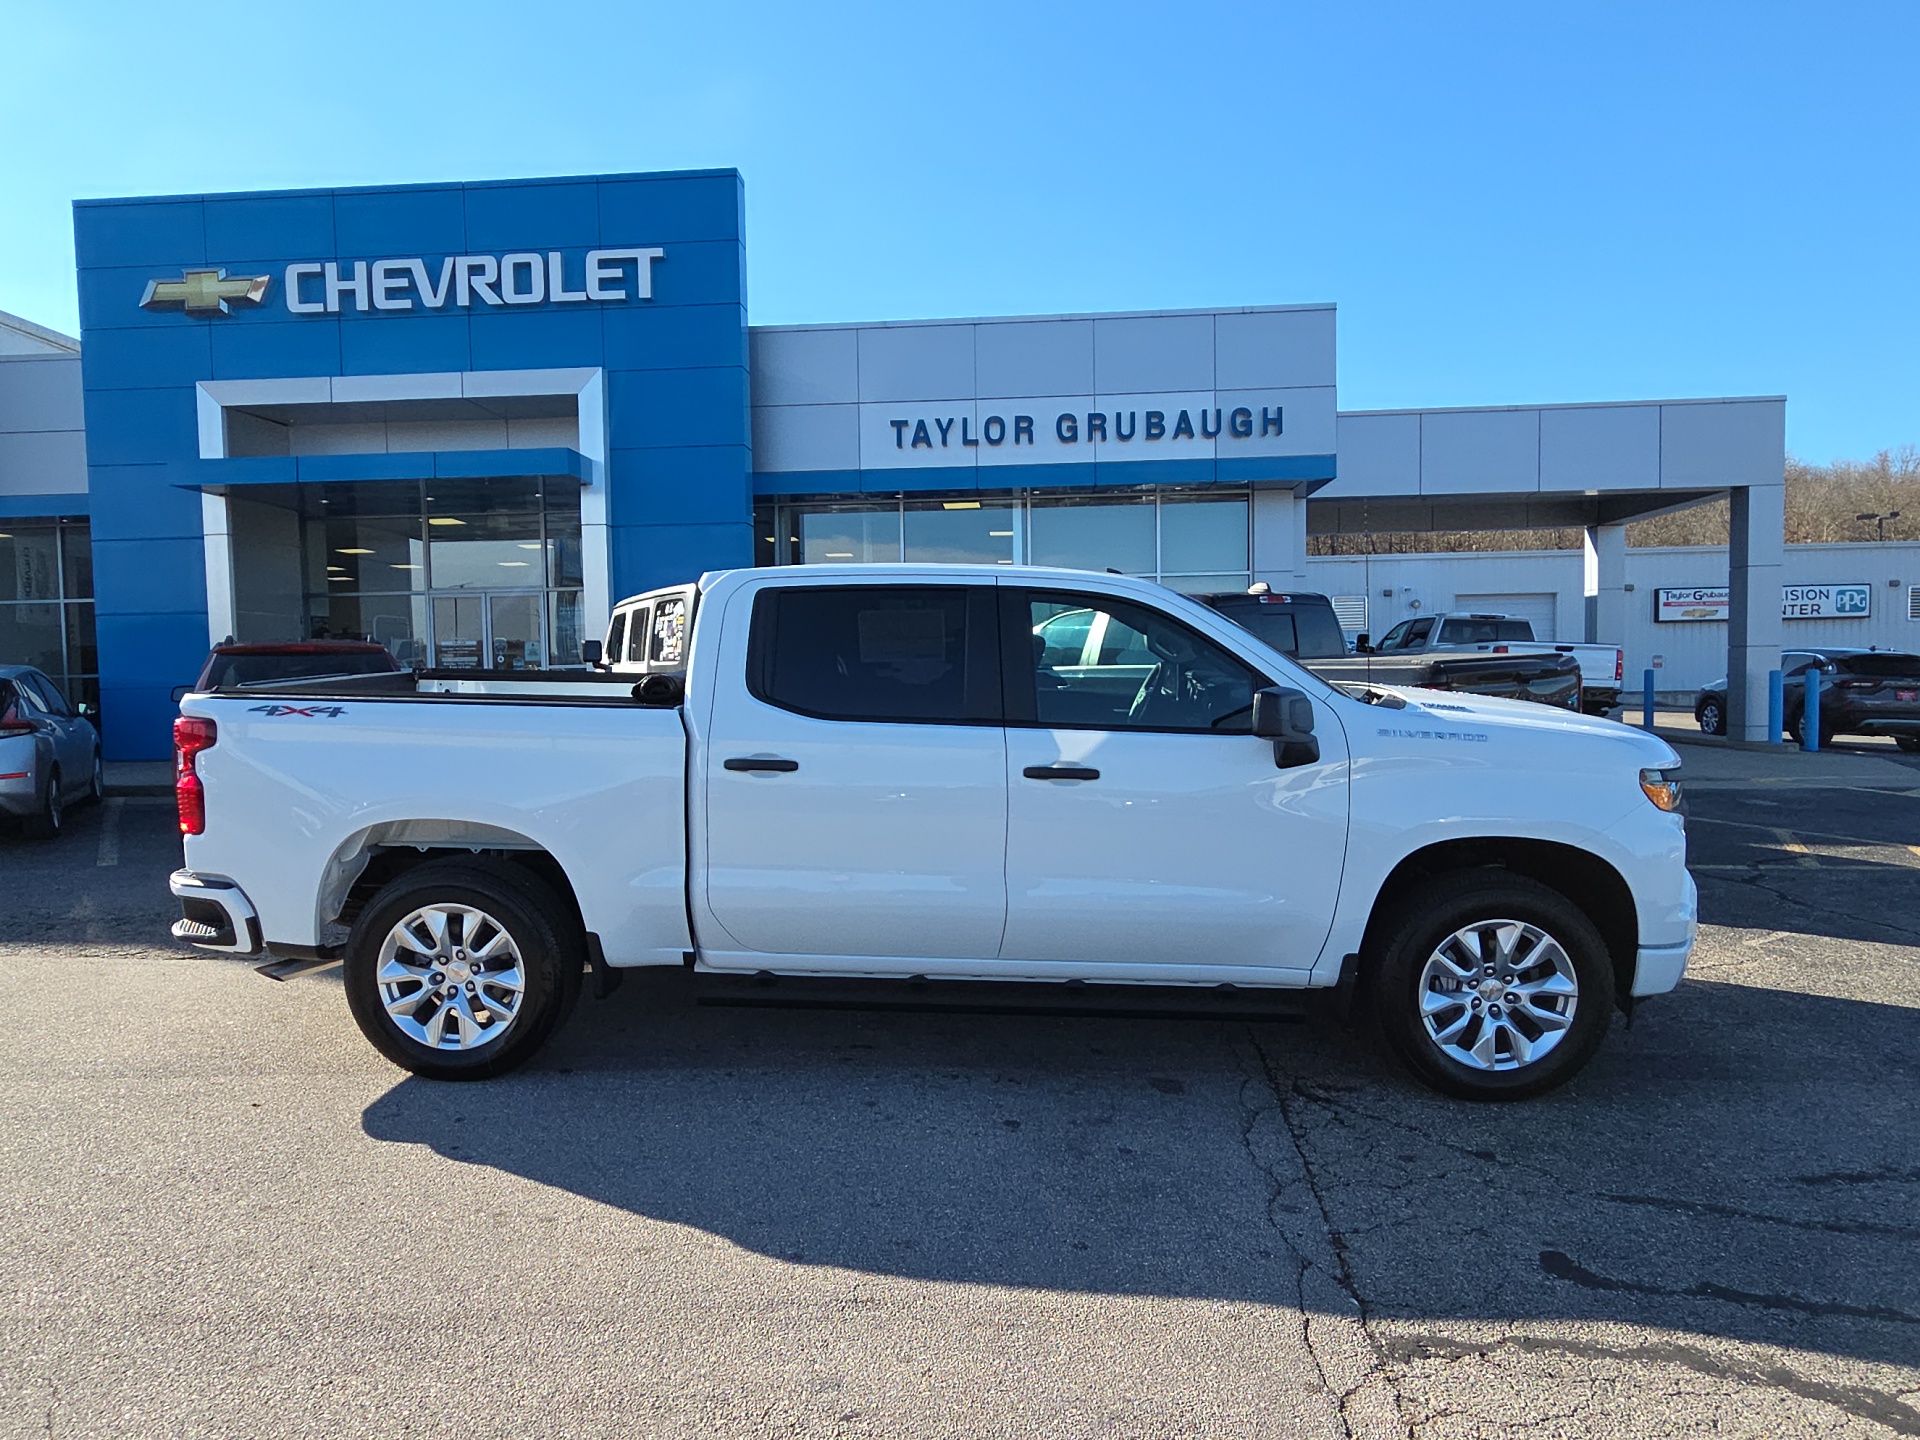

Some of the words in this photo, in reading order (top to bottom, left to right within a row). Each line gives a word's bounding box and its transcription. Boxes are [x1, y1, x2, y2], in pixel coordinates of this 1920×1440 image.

[284, 247, 665, 313] CHEVROLET
[890, 414, 1034, 449] TAYLOR
[1055, 406, 1284, 443] GRUBAUGH
[1663, 590, 1692, 601] Taylor
[1693, 590, 1729, 601] Grubau
[1782, 589, 1830, 601] ISION
[1837, 591, 1866, 611] PPG
[1782, 603, 1821, 616] TER
[1376, 728, 1488, 743] SILVERADO
